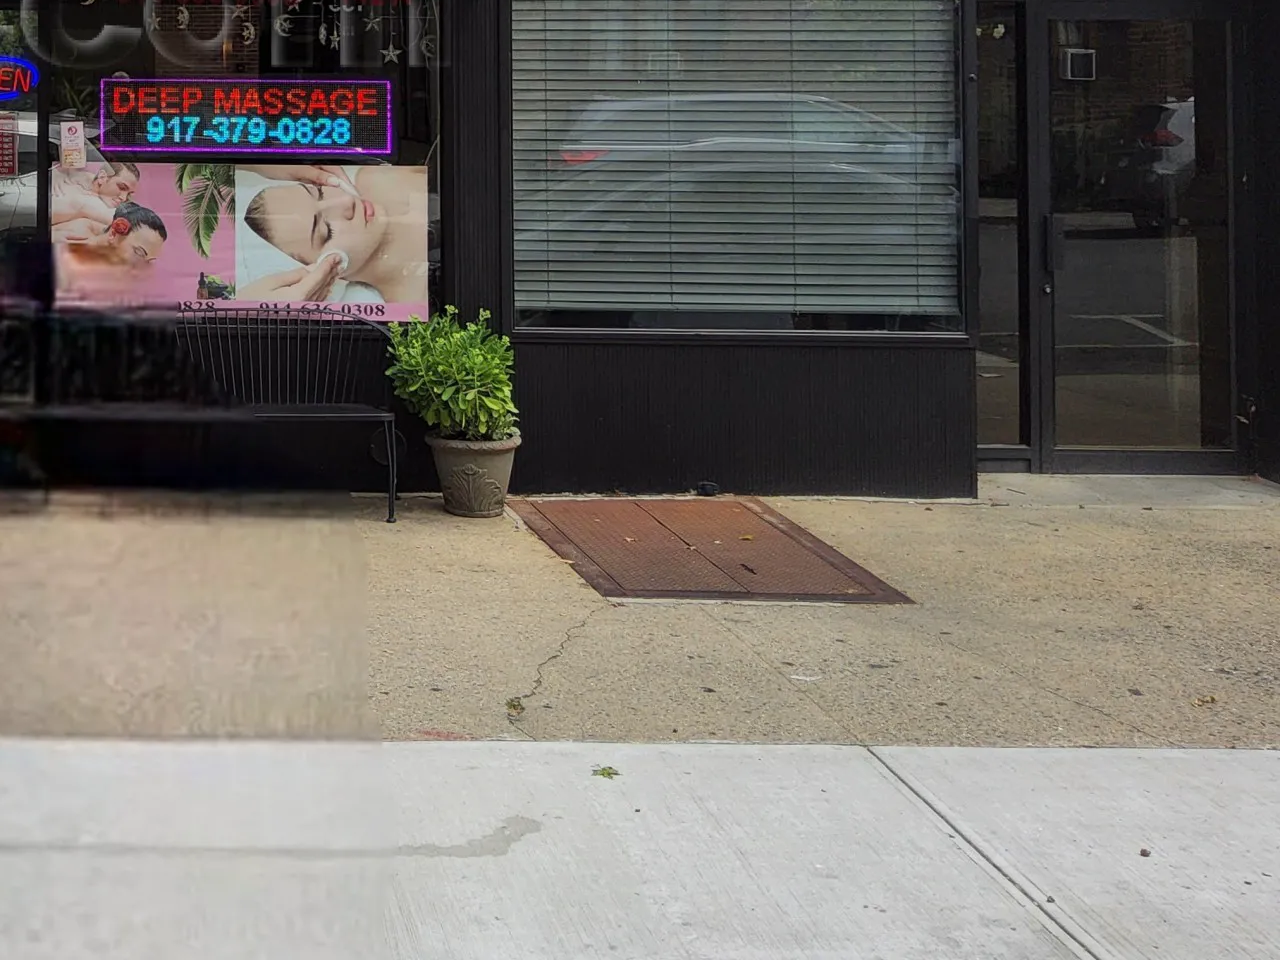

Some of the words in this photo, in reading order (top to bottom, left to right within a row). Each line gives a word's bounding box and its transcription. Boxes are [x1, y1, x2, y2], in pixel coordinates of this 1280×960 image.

[112, 86, 203, 114] DEEP
[213, 87, 378, 116] MASSAGE
[146, 116, 352, 145] 917-379-0828
